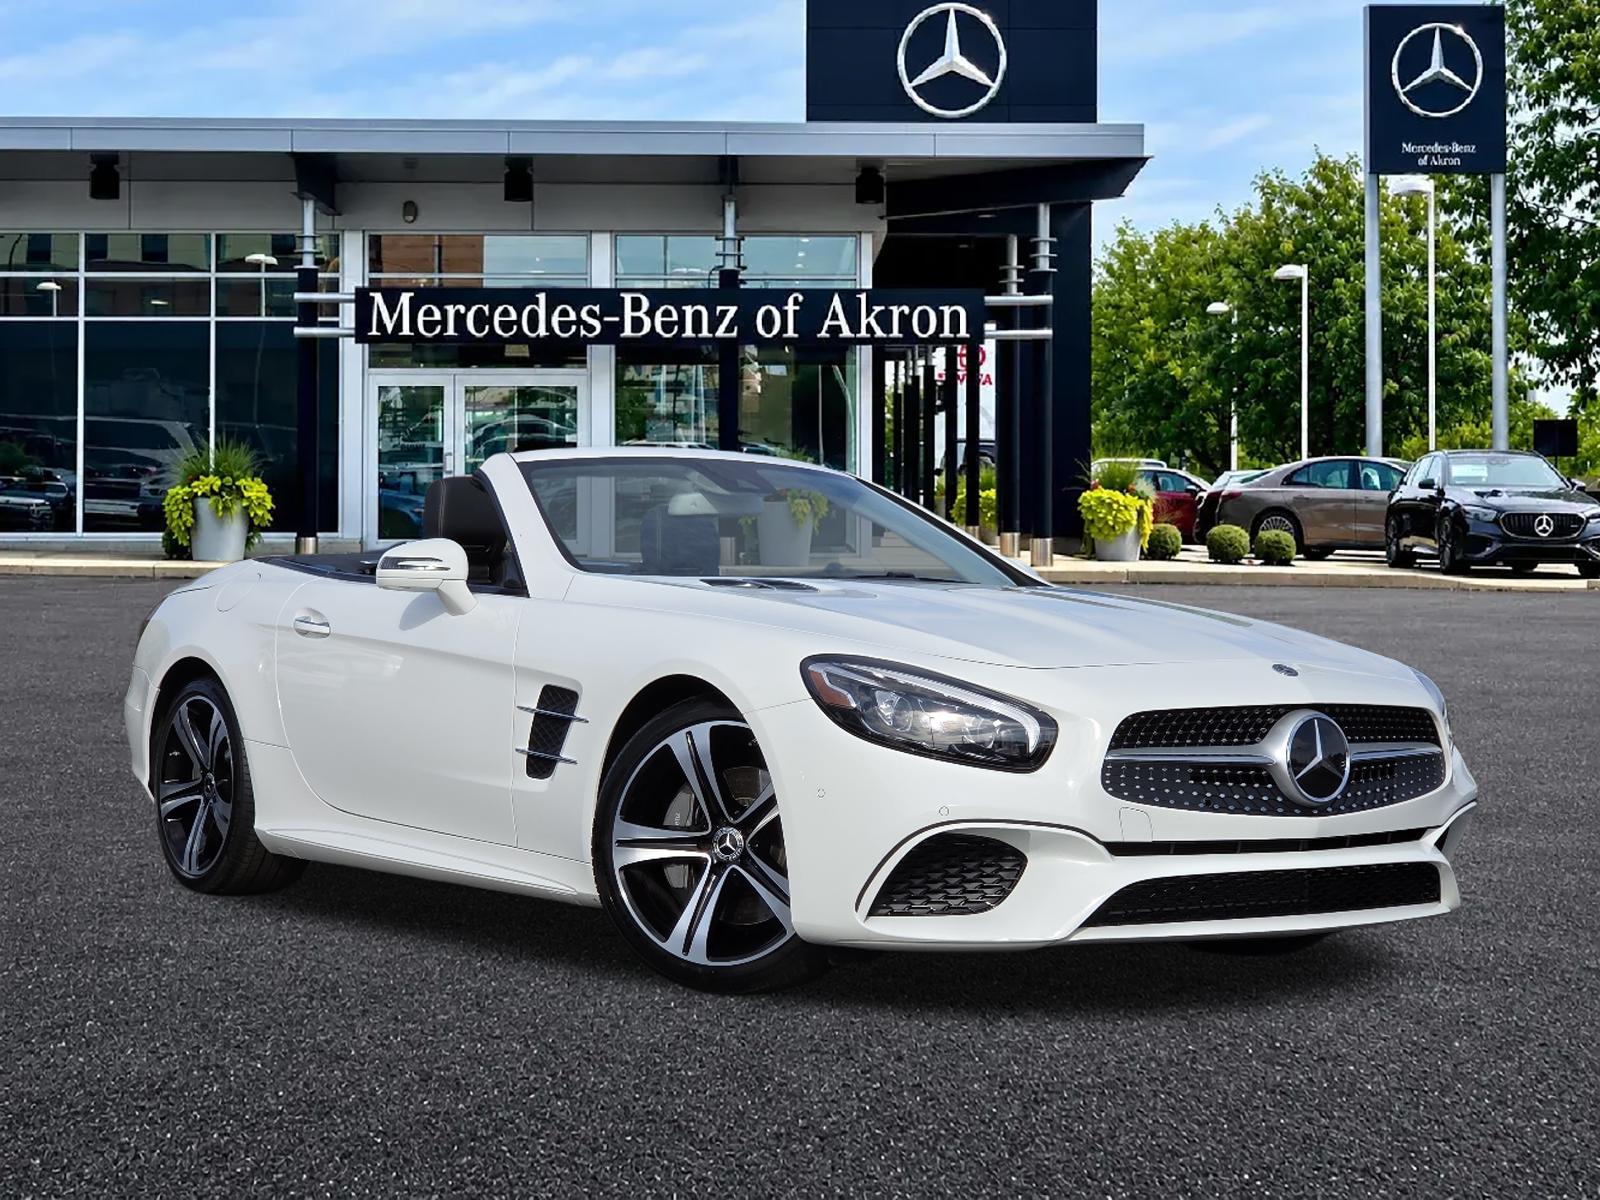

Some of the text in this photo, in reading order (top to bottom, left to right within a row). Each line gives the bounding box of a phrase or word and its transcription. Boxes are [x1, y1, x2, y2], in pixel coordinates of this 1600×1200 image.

[1401, 142, 1476, 153] Mercedes-Benz
[1417, 155, 1460, 165] of Akron
[367, 291, 970, 338] Mercedes-Benz of Akron
